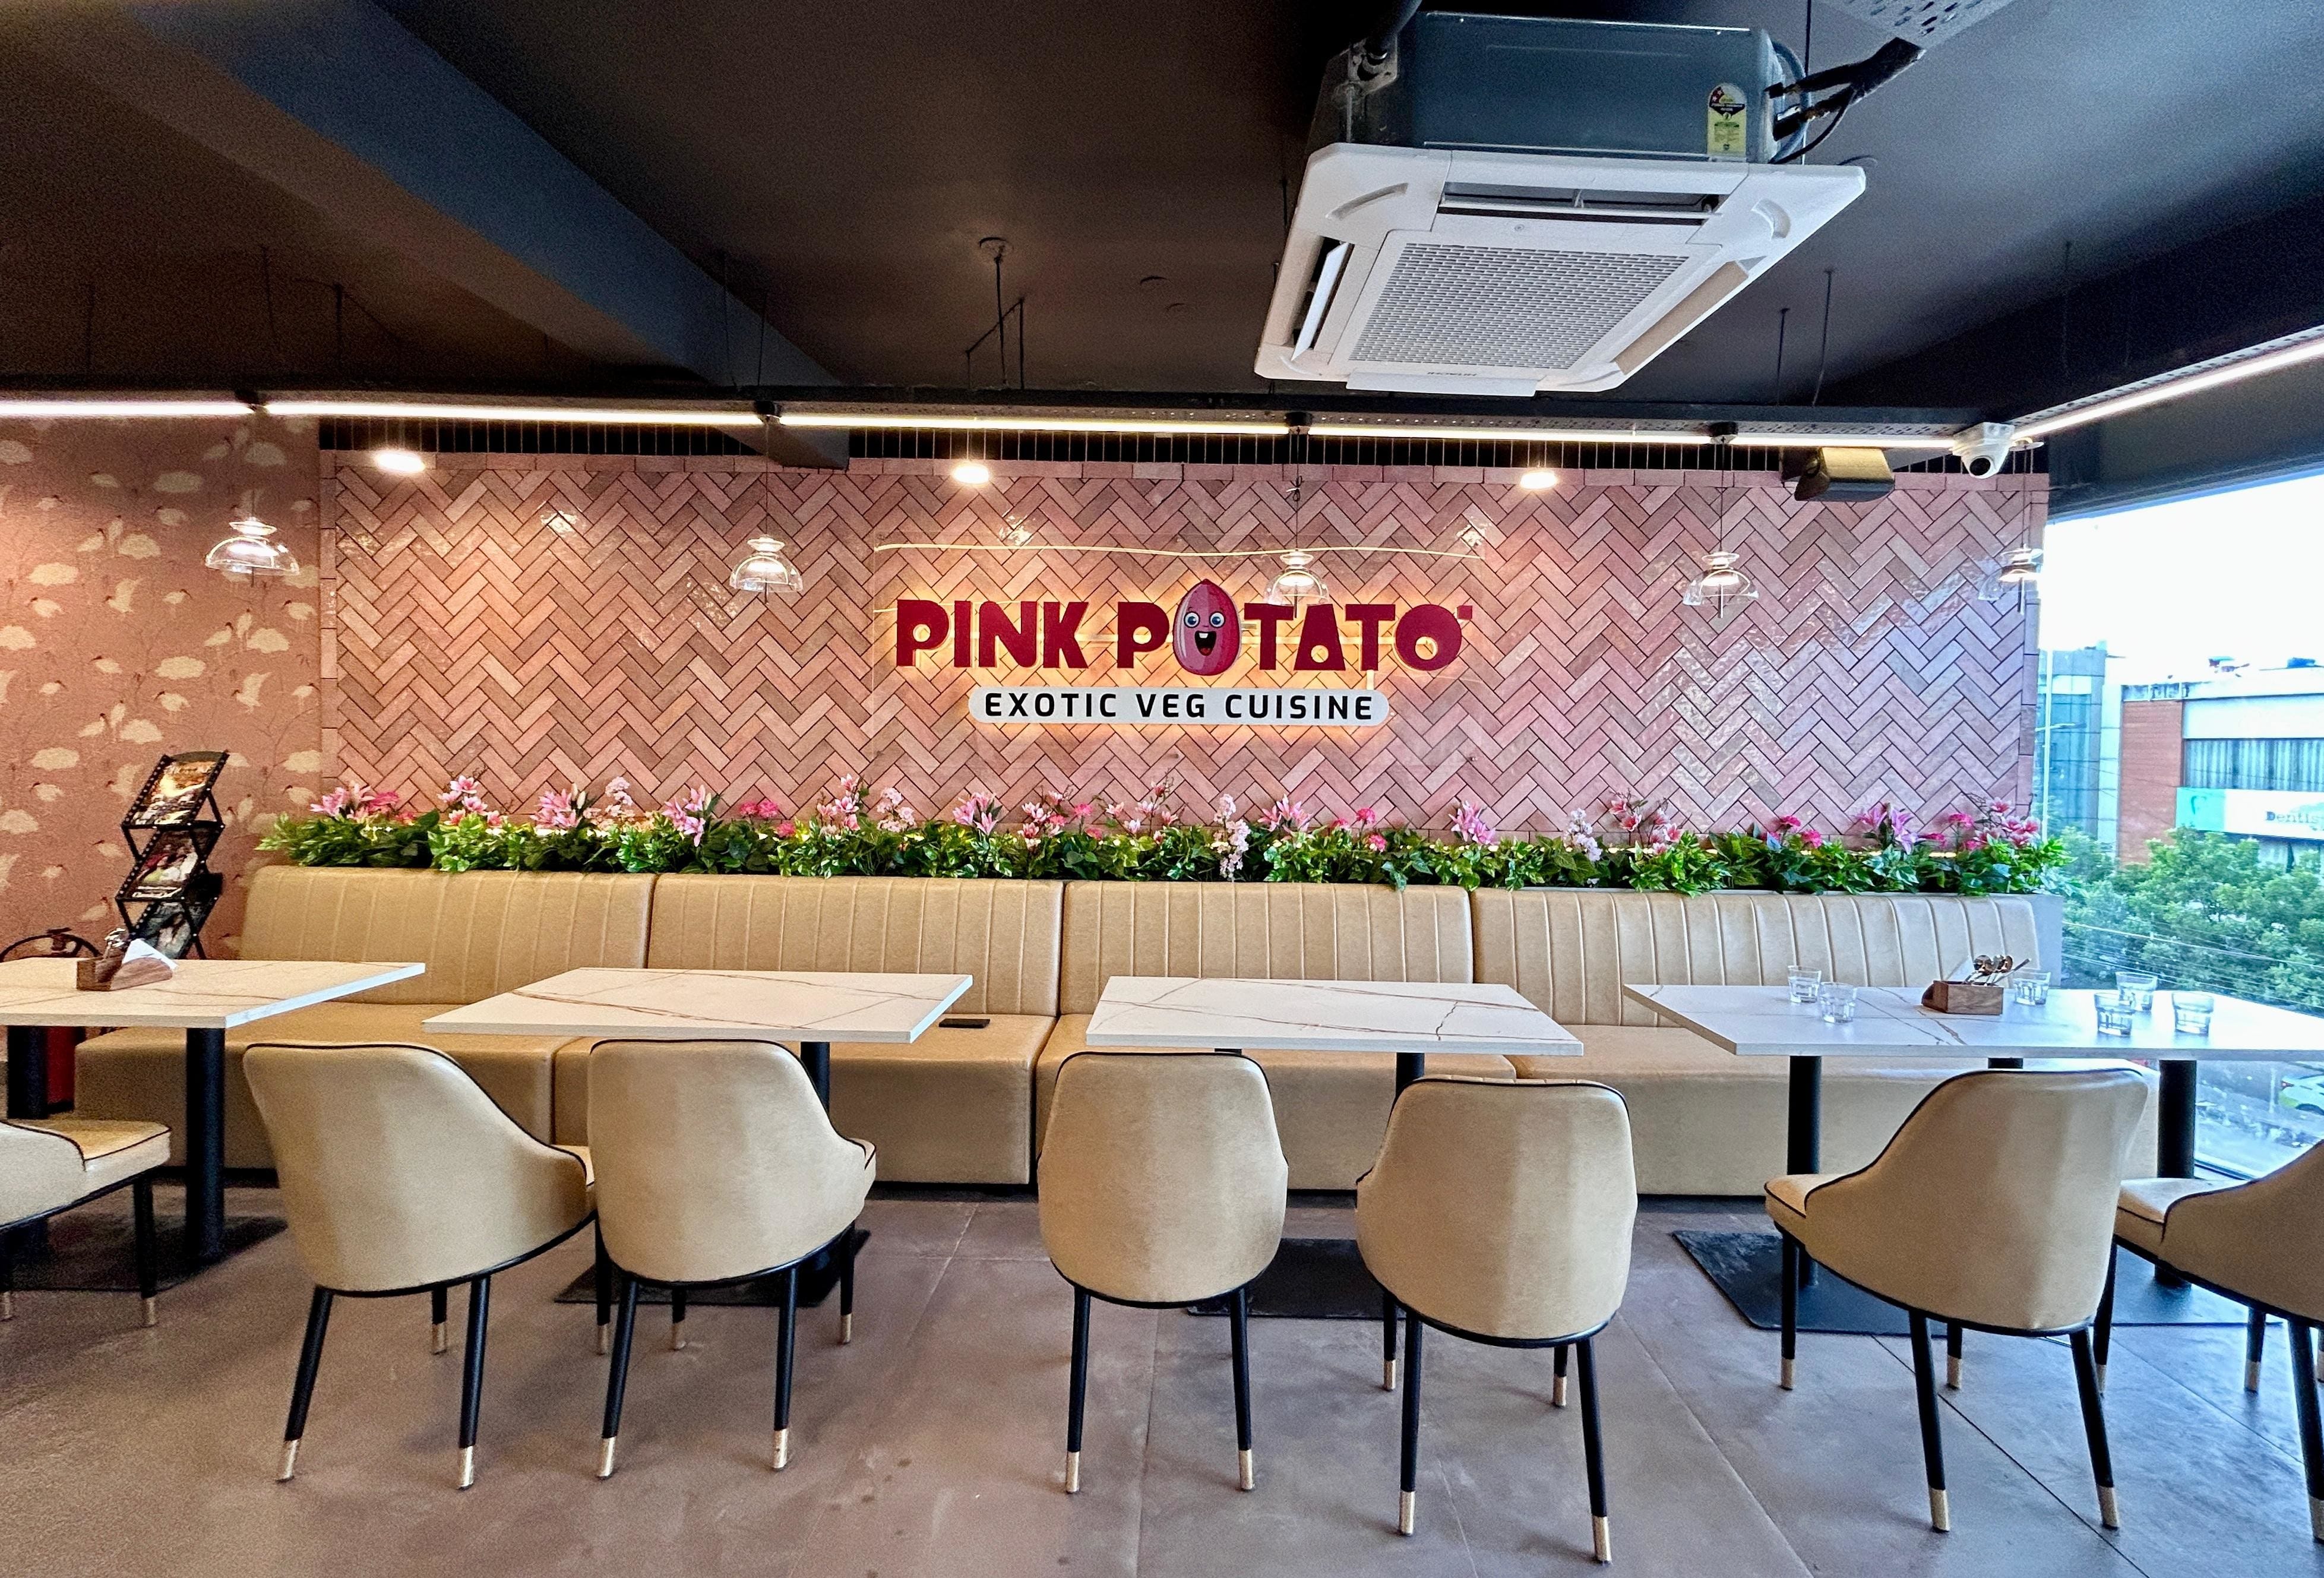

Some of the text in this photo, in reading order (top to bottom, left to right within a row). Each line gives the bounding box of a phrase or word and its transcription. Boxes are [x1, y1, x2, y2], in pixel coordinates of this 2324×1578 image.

[897, 599, 1089, 669] PINK
[985, 692, 1373, 720] EXOTIC VEG CUISINE
